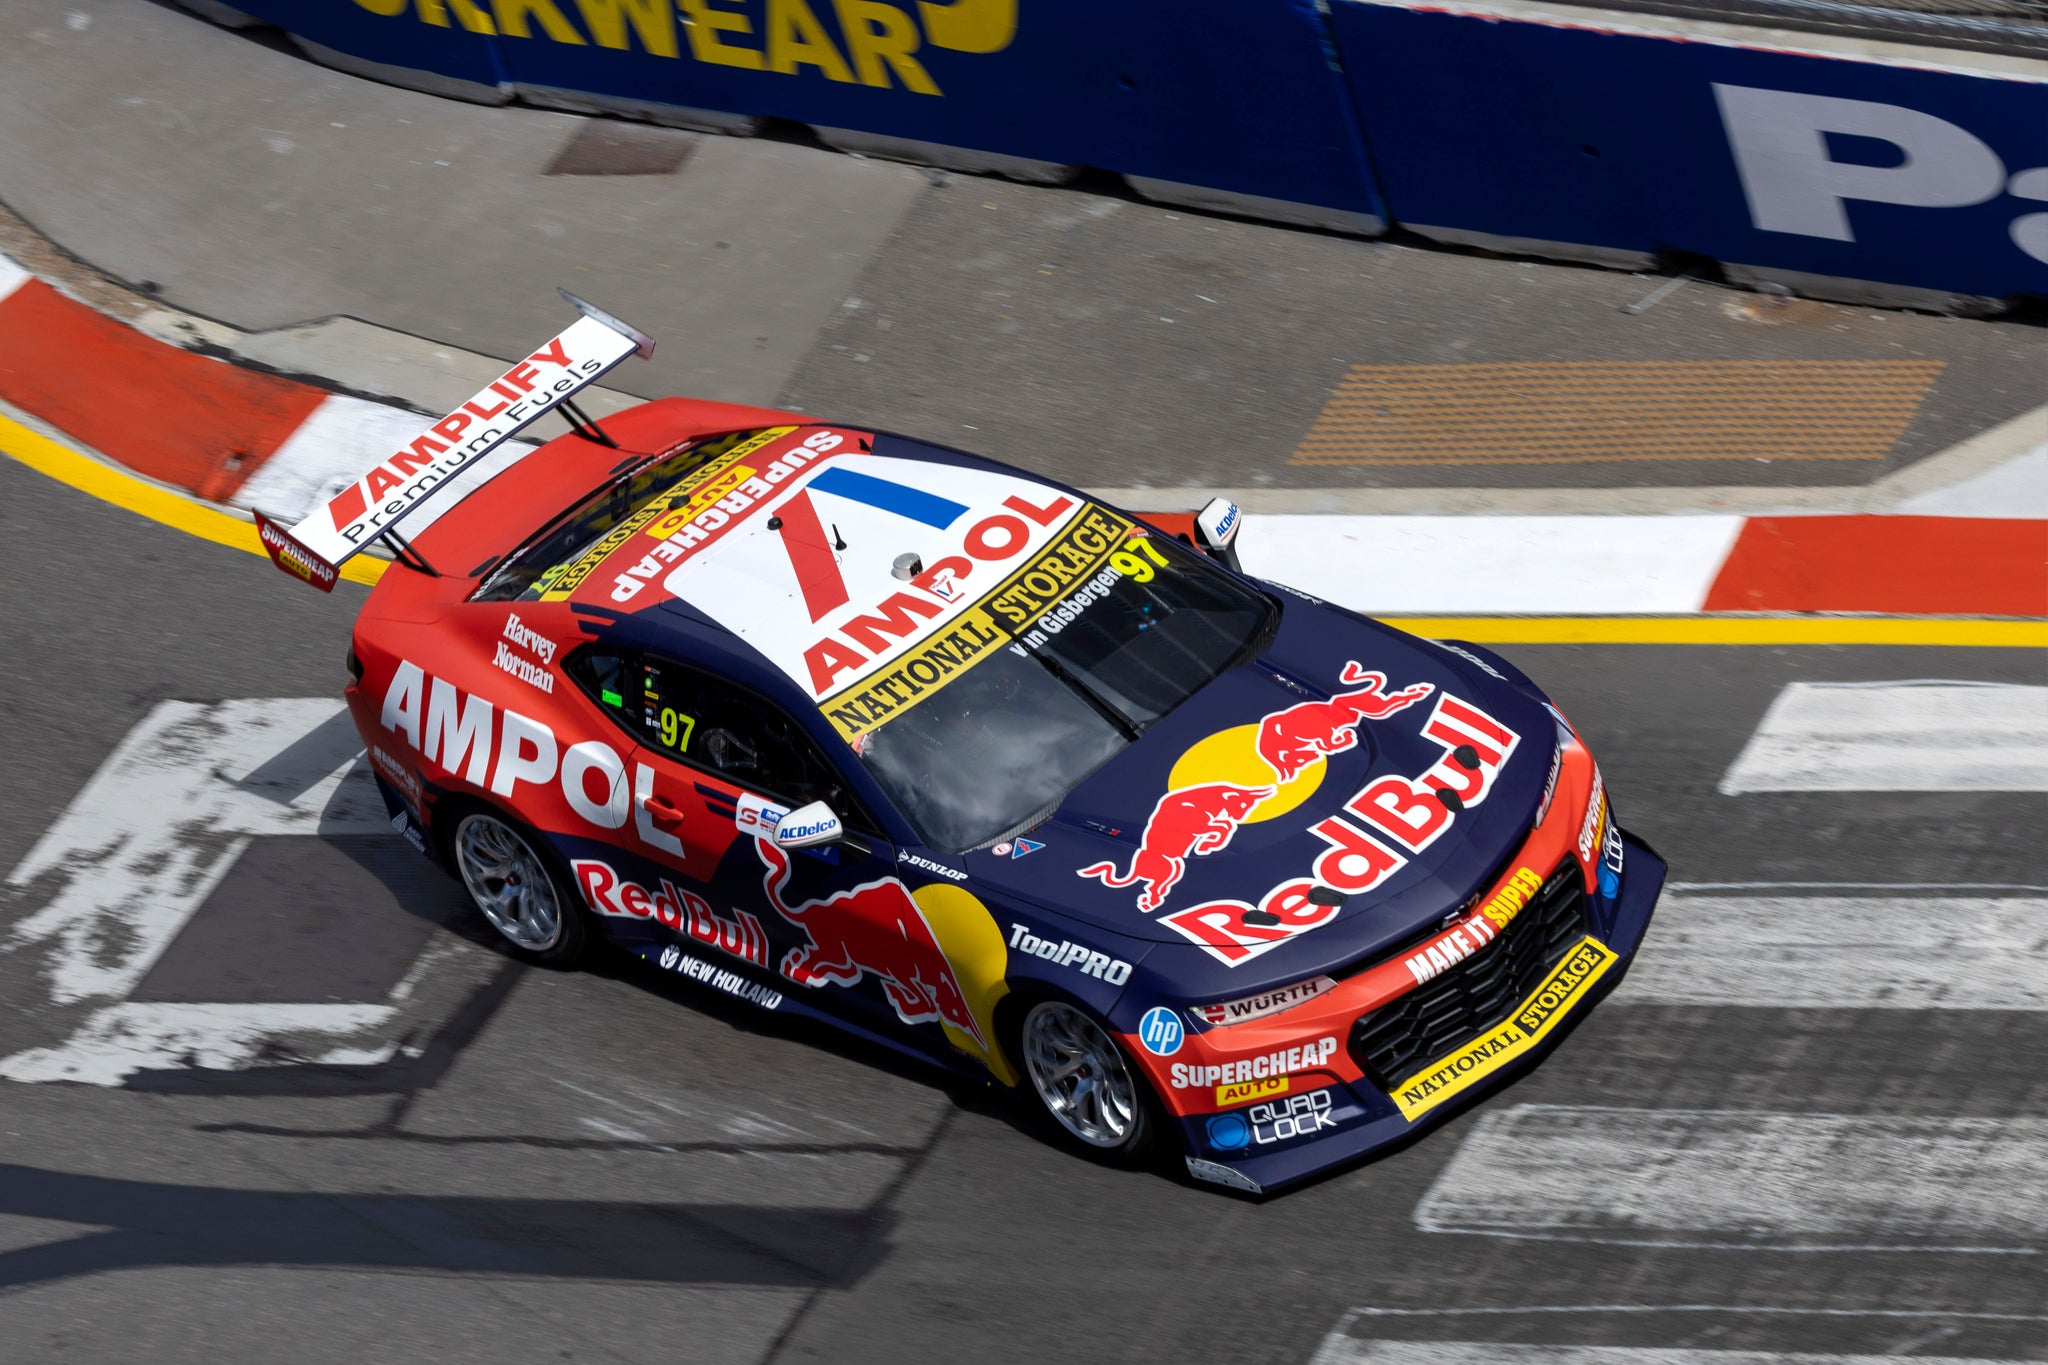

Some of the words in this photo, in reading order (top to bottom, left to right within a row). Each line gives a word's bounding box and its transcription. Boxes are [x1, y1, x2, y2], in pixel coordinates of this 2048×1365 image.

[366, 337, 574, 504] AMPLIFY
[342, 427, 502, 544] Premium
[505, 359, 601, 422] Fuels
[611, 431, 844, 602] SUPERCHEAP
[662, 473, 738, 529] AUTO
[262, 523, 334, 581] SUPERCHEAP
[556, 509, 657, 588] STORAGE
[1109, 537, 1170, 583] 97
[529, 563, 570, 593] 97
[803, 495, 1074, 695] AMPOL
[1038, 566, 1123, 634] Gisbergen
[503, 613, 557, 665] Harvey
[829, 619, 999, 734] NATIONAL
[991, 512, 1119, 624] STORAGE
[492, 641, 554, 694] Norman
[661, 707, 695, 753] 97
[381, 659, 686, 859] AMPOL
[780, 819, 837, 839] ACDelco
[907, 854, 968, 881] DUNLOP
[1404, 929, 1476, 985] MAKE
[1463, 914, 1495, 948] IT
[1482, 867, 1544, 929] SUPER
[1009, 923, 1133, 986] ToolPRO
[678, 955, 717, 982] NEW
[712, 969, 783, 1010] HOLLAND
[1230, 981, 1318, 1017] WÜRTH
[1147, 1010, 1179, 1054] hp
[1401, 1029, 1523, 1107] NATIONAL
[1518, 947, 1601, 1029] STORAGE
[1171, 1036, 1337, 1089] SUPERCHEAP
[1224, 1077, 1281, 1100] AUTO
[1249, 1089, 1332, 1124] QUAD
[1252, 1107, 1337, 1144] LOCK
